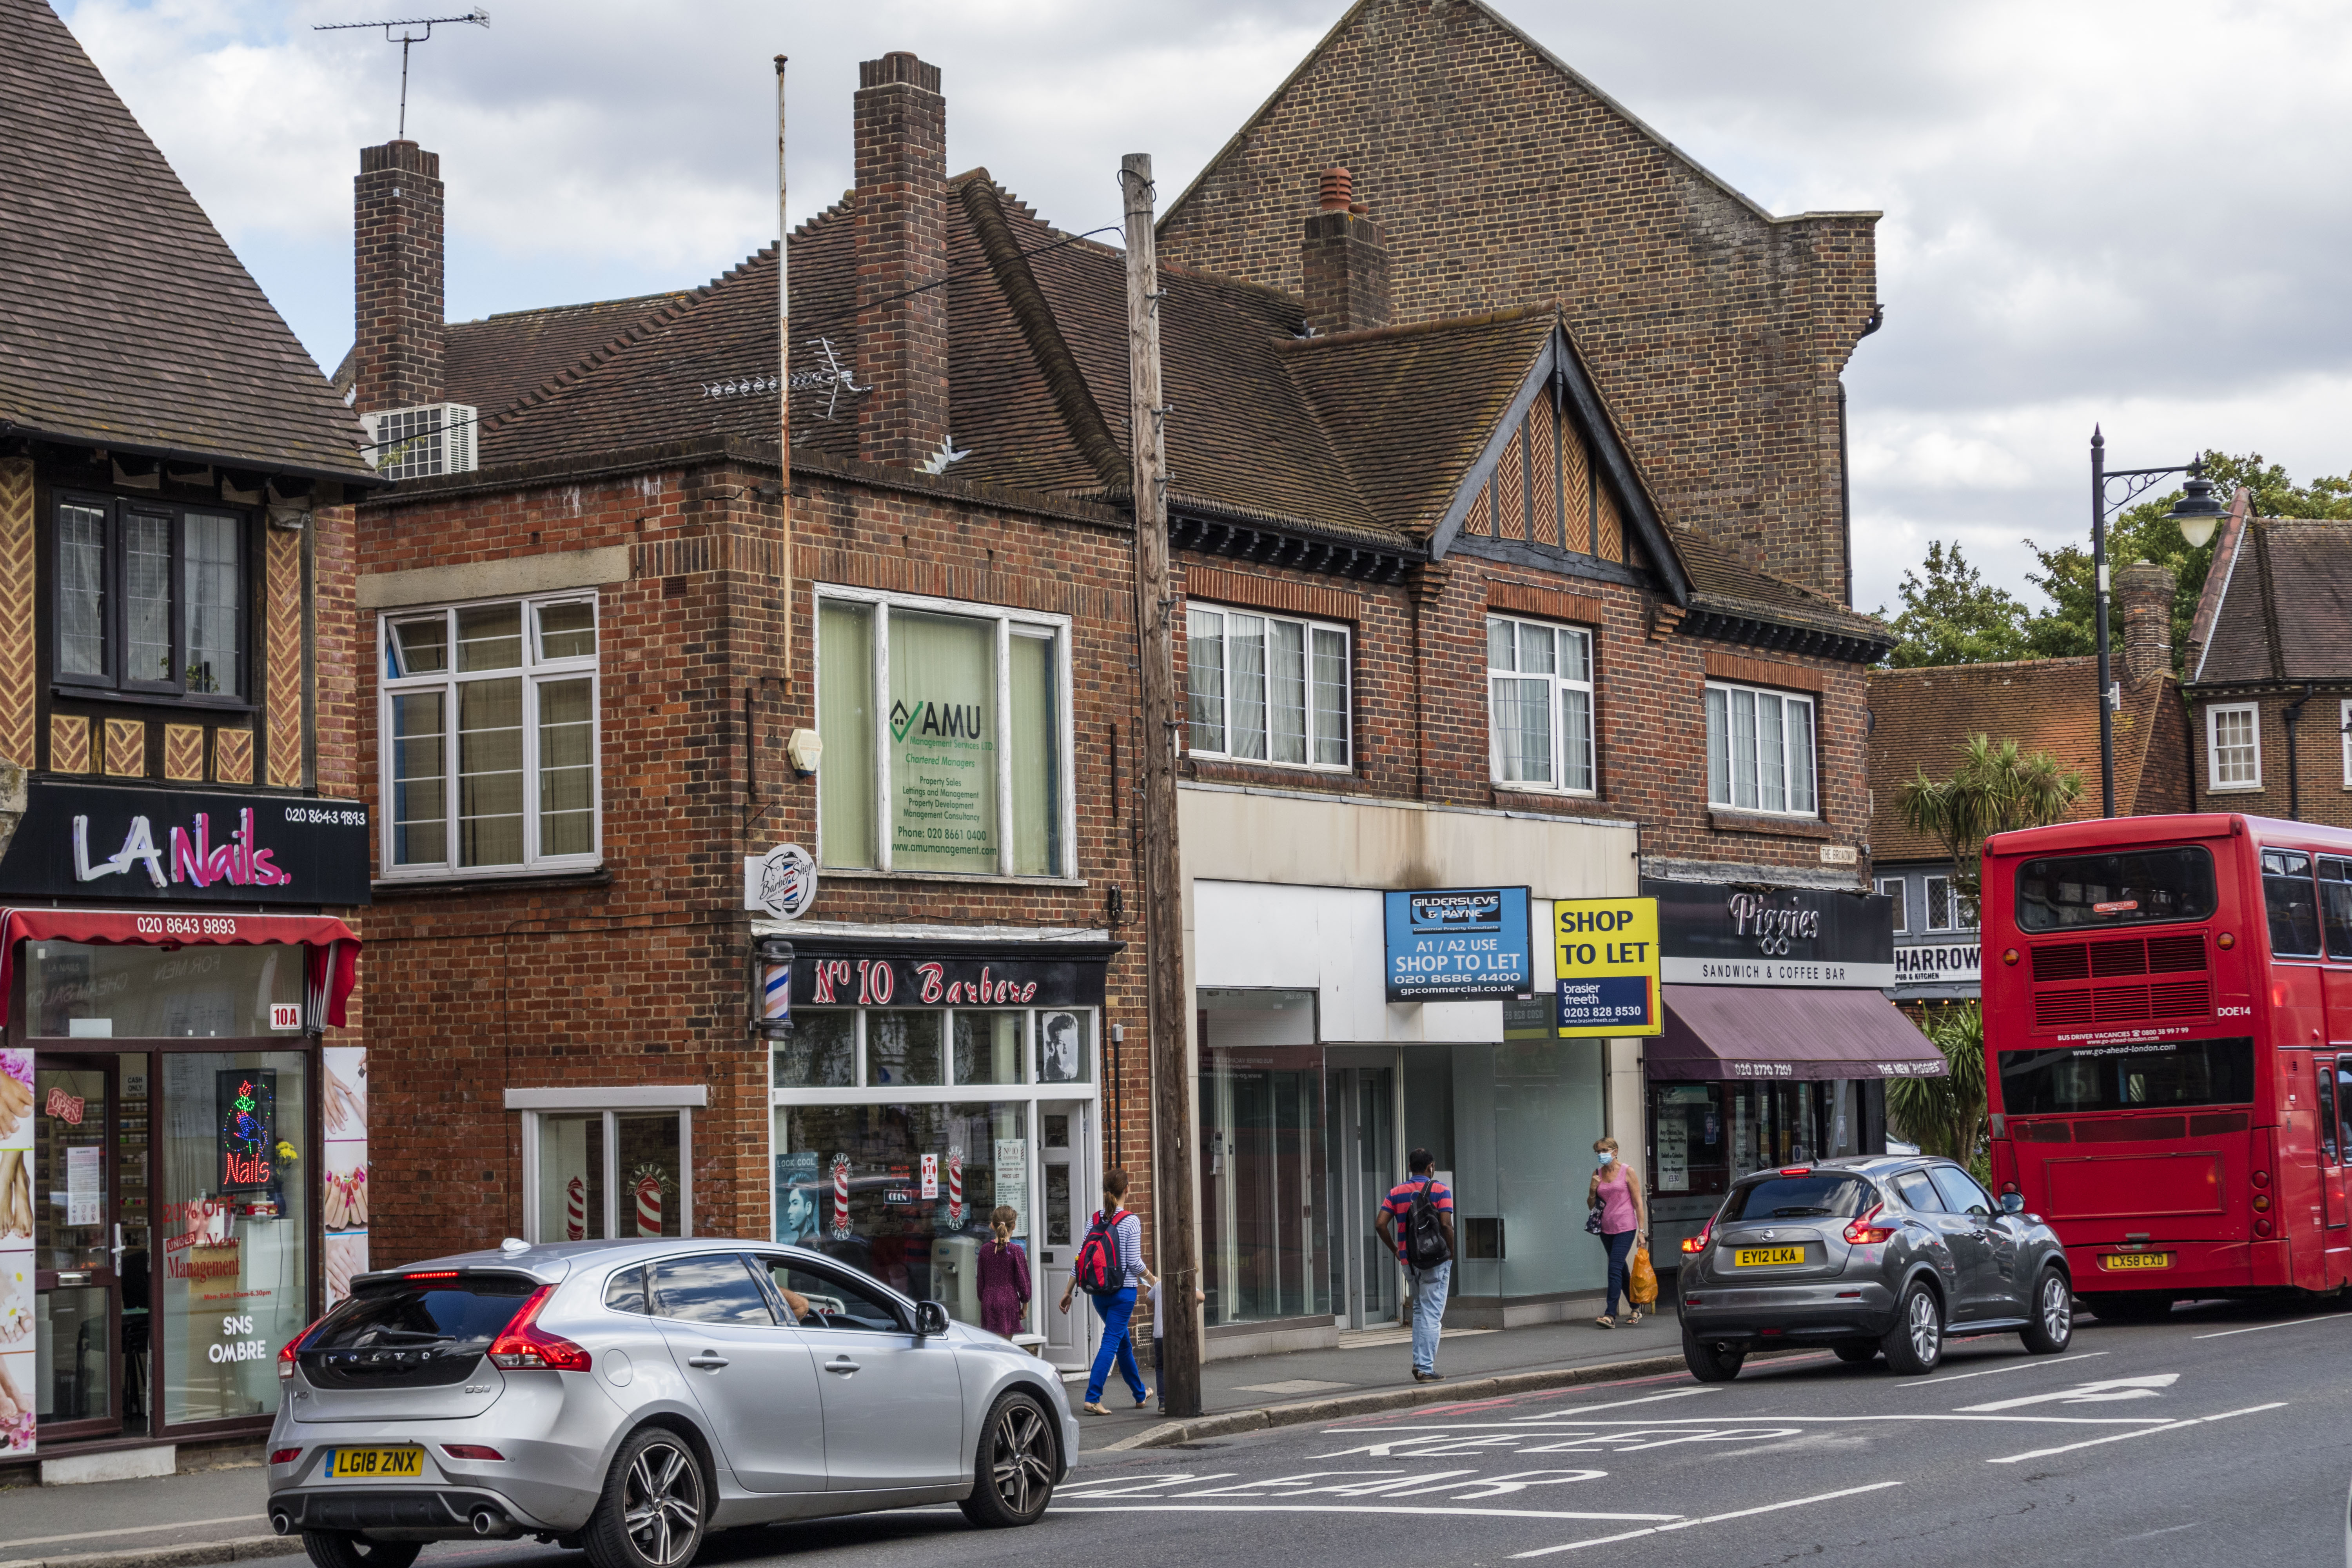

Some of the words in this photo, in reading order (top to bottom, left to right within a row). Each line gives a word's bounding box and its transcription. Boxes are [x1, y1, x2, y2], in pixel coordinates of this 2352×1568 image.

[922, 701, 980, 740] AMU
[910, 736, 952, 748] Management
[954, 739, 979, 750] Services
[981, 742, 995, 751] LTD.
[906, 753, 939, 765] Chartered
[941, 756, 975, 769] Managers
[920, 776, 944, 788] Property
[946, 778, 962, 786] Sales
[903, 786, 925, 797] Lettings
[927, 788, 938, 796] and
[940, 789, 979, 800] Management
[909, 798, 933, 809] Property
[935, 799, 974, 810] Development
[285, 807, 306, 822] 020
[309, 809, 339, 824] 8643
[341, 811, 365, 826] 9893
[903, 809, 942, 820] Management
[944, 811, 980, 823] Consultancy
[898, 826, 925, 838] Phone:
[927, 828, 942, 838] 020
[945, 829, 963, 840] 8661
[967, 830, 986, 841] 0400
[73, 815, 168, 888] LA
[1822, 849, 1831, 859] THE
[1833, 849, 1855, 861] BROADWAY
[759, 875, 790, 900] Barber
[792, 862, 813, 882] Shop
[1412, 896, 1498, 907] GILDERSLEVE
[1442, 909, 1483, 918] PAYNE
[137, 917, 162, 933] 020
[166, 918, 199, 934] 8643
[203, 919, 236, 935] 9893
[1561, 910, 1634, 933] SHOP
[1727, 893, 1819, 956] Piggies
[1416, 941, 1433, 952] A1
[1438, 940, 1444, 953] /
[1447, 940, 1466, 951] A2
[1471, 939, 1497, 951] USE
[1561, 943, 1596, 965] TO
[1607, 942, 1650, 964] LET
[1396, 956, 1448, 972] SHOP
[1454, 955, 1480, 970] TO
[1488, 954, 1520, 969] LET
[1896, 947, 1981, 971] HARROW
[1394, 975, 1426, 984] 020
[1431, 974, 1472, 982] 8686
[1477, 973, 1521, 982] 4400
[1703, 964, 1760, 978] SANDWICH
[1767, 965, 1772, 978] &
[1780, 965, 1819, 980] COFFEE
[1826, 967, 1845, 980] BAR
[857, 960, 894, 1005] 10
[916, 962, 1037, 1004] Barbers
[1401, 984, 1515, 995] gpcommercial.co.uk
[1564, 982, 1600, 994] brasier
[1564, 994, 1599, 1005] freeth
[1564, 1007, 1590, 1018] 0203
[1593, 1007, 1612, 1017] 828
[1615, 1006, 1641, 1016] 8530
[2218, 1006, 2250, 1016] DOE14
[2087, 1036, 2159, 1045] www.go-ahead-london.com
[2073, 1044, 2176, 1056] www.go-ahead-london.com
[1735, 1063, 1751, 1075] 020
[1754, 1064, 1773, 1076] 8770
[1774, 1064, 1792, 1076] 7209
[1877, 1064, 1894, 1074] THE
[1893, 1064, 1910, 1074] NEW
[51, 1095, 79, 1121] OPEN
[223, 1152, 270, 1185] Nails
[777, 1159, 794, 1167] LOOK
[797, 1158, 815, 1166] COOL
[830, 1154, 852, 1173] BARBER
[629, 1163, 667, 1187] BARBER
[889, 1193, 907, 1201] OPEN
[163, 1201, 197, 1224] 20%
[202, 1195, 236, 1218] OFF
[167, 1233, 195, 1250] UNDER
[203, 1232, 240, 1250] New
[834, 1228, 851, 1240] SHOP
[1743, 1250, 1769, 1263] EY12
[1773, 1249, 1796, 1261] LKA
[2112, 1256, 2140, 1267] LX58
[2143, 1255, 2163, 1265] CXD
[167, 1256, 240, 1283] Management
[233, 1290, 271, 1298] 10am-6.30pm
[223, 1315, 253, 1336] SNS
[209, 1339, 266, 1363] OMBRE
[328, 1352, 430, 1363] VOLVO
[1305, 1428, 1802, 1458] KEEP
[339, 1452, 377, 1473] LG18
[381, 1452, 417, 1472] ZNX
